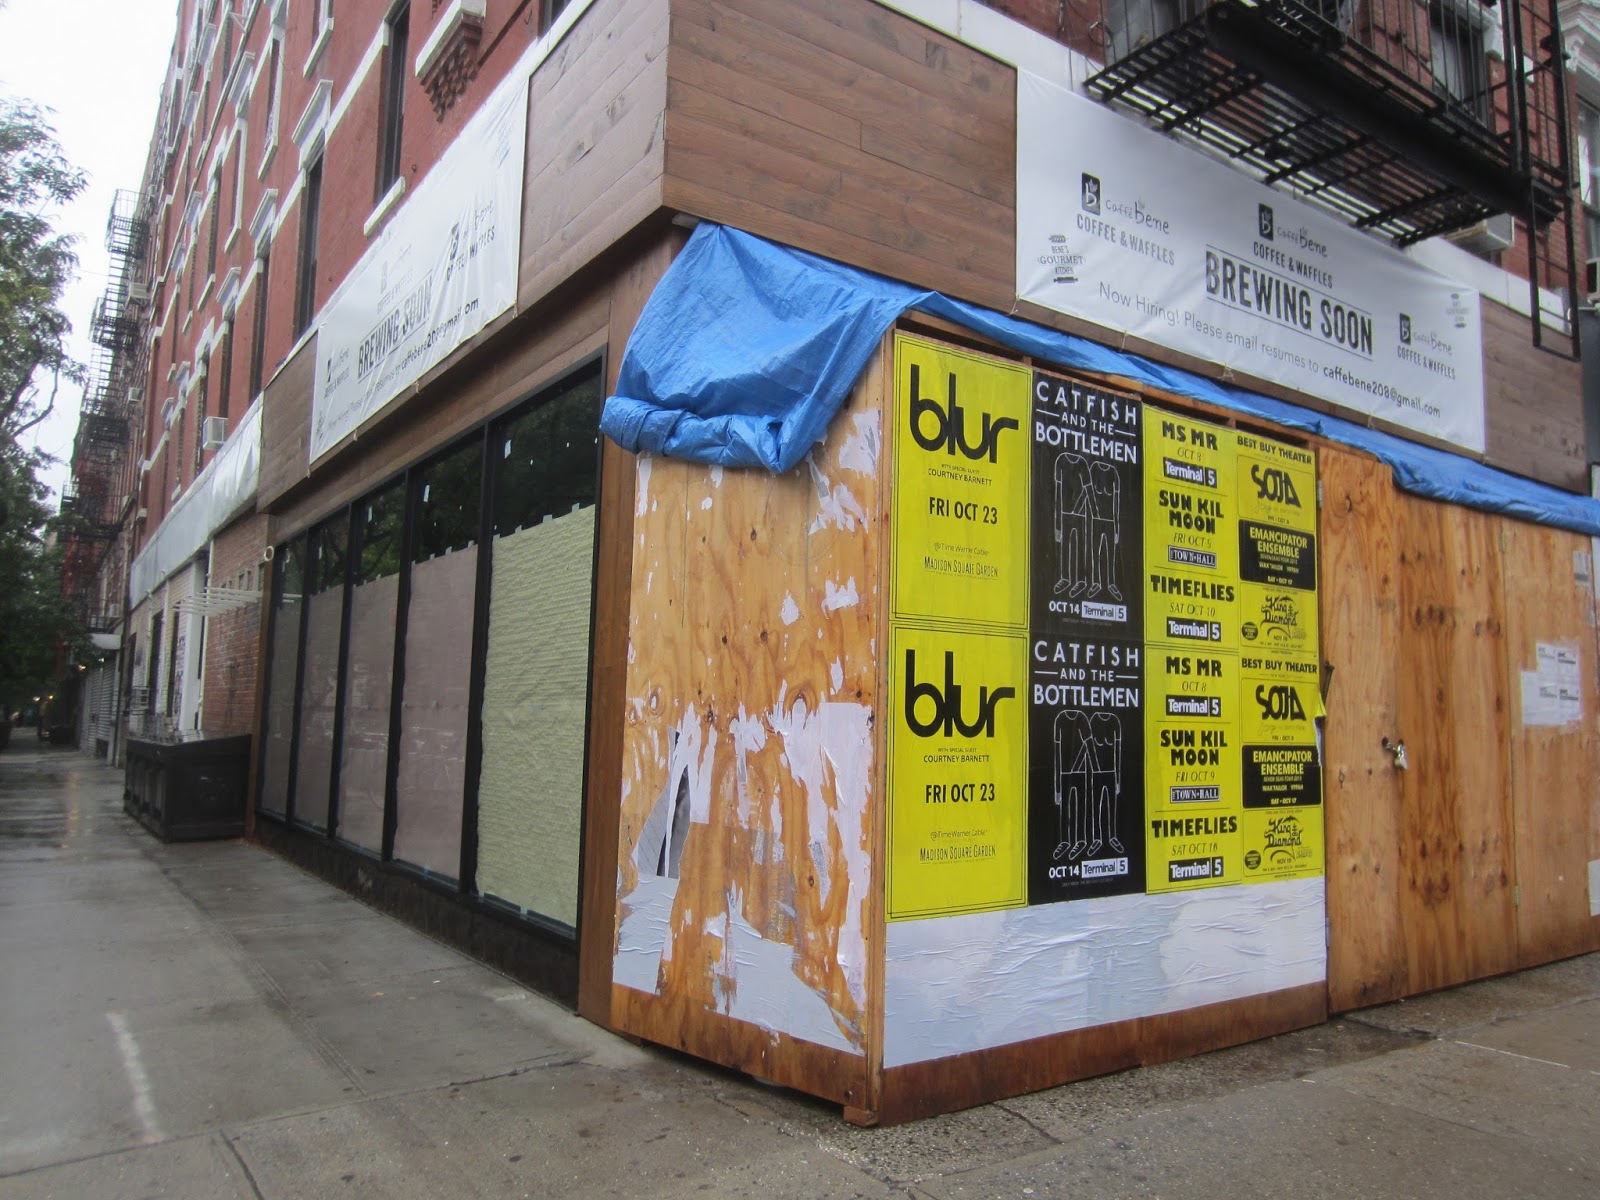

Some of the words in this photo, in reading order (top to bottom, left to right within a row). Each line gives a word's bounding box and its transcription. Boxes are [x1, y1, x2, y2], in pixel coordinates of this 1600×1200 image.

[1077, 213, 1116, 243] COFFEE
[1120, 231, 1127, 248] &
[1129, 233, 1175, 266] WAFFLES
[1040, 255, 1084, 264] GOURMET
[1253, 241, 1285, 268] COFFEE
[1289, 257, 1294, 272] &
[1296, 261, 1333, 289] WAFFLES
[1206, 251, 1312, 331] BREWING
[1320, 299, 1373, 355] SOON
[358, 309, 399, 379] BREWING
[402, 275, 433, 336] SOON
[1099, 281, 1131, 307] Now
[1136, 294, 1180, 326] Hiring!
[1185, 312, 1222, 339] Please
[1226, 332, 1258, 350] email
[1261, 343, 1305, 368] resumes
[1309, 359, 1319, 373] to
[1323, 366, 1441, 418] caffebene208@gmail.com
[1397, 345, 1421, 366] COFFEE
[1428, 358, 1455, 380] WAFFLES
[910, 363, 1019, 464] blur
[1036, 381, 1136, 426] CATFISH
[1061, 411, 1086, 427] AND
[1091, 419, 1114, 435] THE
[1035, 421, 1137, 464] BOTTLEMEN
[1162, 420, 1186, 443] MS
[1191, 428, 1218, 451] MR
[1177, 447, 1195, 460] OCT
[1197, 452, 1202, 462] 8
[1237, 435, 1257, 449] BEST
[1259, 442, 1276, 455] BUY
[1278, 447, 1312, 465] THEATER
[928, 468, 963, 481] COURTNEY
[964, 474, 993, 486] BARNETT
[1165, 460, 1203, 482] Terminal
[1208, 470, 1215, 486] 5
[1251, 464, 1302, 508] SOJA
[929, 496, 950, 517] FRI
[954, 501, 978, 521] OCT
[982, 505, 998, 525] 23
[1159, 489, 1192, 512] SUN
[1197, 497, 1225, 519] KIL
[1168, 509, 1216, 535] MOON
[1173, 532, 1186, 544] FRI
[1188, 535, 1206, 547] OCT
[1249, 526, 1308, 549] EMANCIPATOR
[1257, 541, 1300, 559] ENSEMBLE
[924, 556, 952, 572] MADISON
[976, 562, 999, 578] GARDEN
[1150, 574, 1235, 603] TIMEFLIES
[1049, 600, 1068, 613] OCT
[1069, 603, 1080, 614] 14
[1083, 605, 1115, 618] Terminal
[1118, 608, 1124, 620] 5
[1169, 602, 1185, 614] SAT
[1187, 604, 1204, 616] OCT
[1207, 607, 1216, 617] 10
[1168, 620, 1208, 638] Terminal
[1212, 624, 1220, 640] 5
[1034, 640, 1139, 667] CATFISH
[1060, 667, 1086, 680] AND
[1091, 669, 1115, 682] THE
[1166, 655, 1191, 675] MS
[1196, 658, 1223, 677] MR
[1241, 658, 1262, 669] BEST
[1265, 660, 1283, 671] BUY
[1285, 661, 1317, 674] THEATER
[905, 648, 1015, 738] blur
[1034, 684, 1139, 708] BOTTLEMEN
[1181, 680, 1200, 692] OCT
[1201, 682, 1207, 692] 8
[1167, 698, 1208, 714] Terminal
[1212, 698, 1219, 715] 5
[1255, 684, 1307, 721] SOJA
[1160, 729, 1195, 748] SUN
[1201, 730, 1228, 748] KIL
[923, 755, 960, 763] COURTNEY
[961, 754, 989, 762] BARNETT
[1170, 748, 1219, 767] MOON
[1253, 750, 1312, 763] EMANCIPATOR
[1175, 771, 1188, 782] FRI
[1190, 771, 1208, 782] OCT
[1210, 770, 1215, 780] 9
[1261, 763, 1304, 775] ENSEMBLE
[926, 784, 946, 803] FRI
[950, 784, 975, 803] OCT
[980, 783, 995, 801] 23
[1151, 815, 1238, 838] TIMEFLIES
[920, 847, 948, 861] MADISON
[950, 846, 972, 859] SQUARE
[974, 844, 996, 858] GARDEN
[1171, 844, 1186, 856] SAT
[1188, 842, 1207, 854] OCT
[1048, 866, 1067, 879] OCT
[1069, 865, 1080, 876] 14
[1083, 862, 1116, 875] Terminal
[1119, 860, 1126, 872] 5
[1170, 861, 1210, 878] Terminal
[1214, 858, 1222, 875] 5
